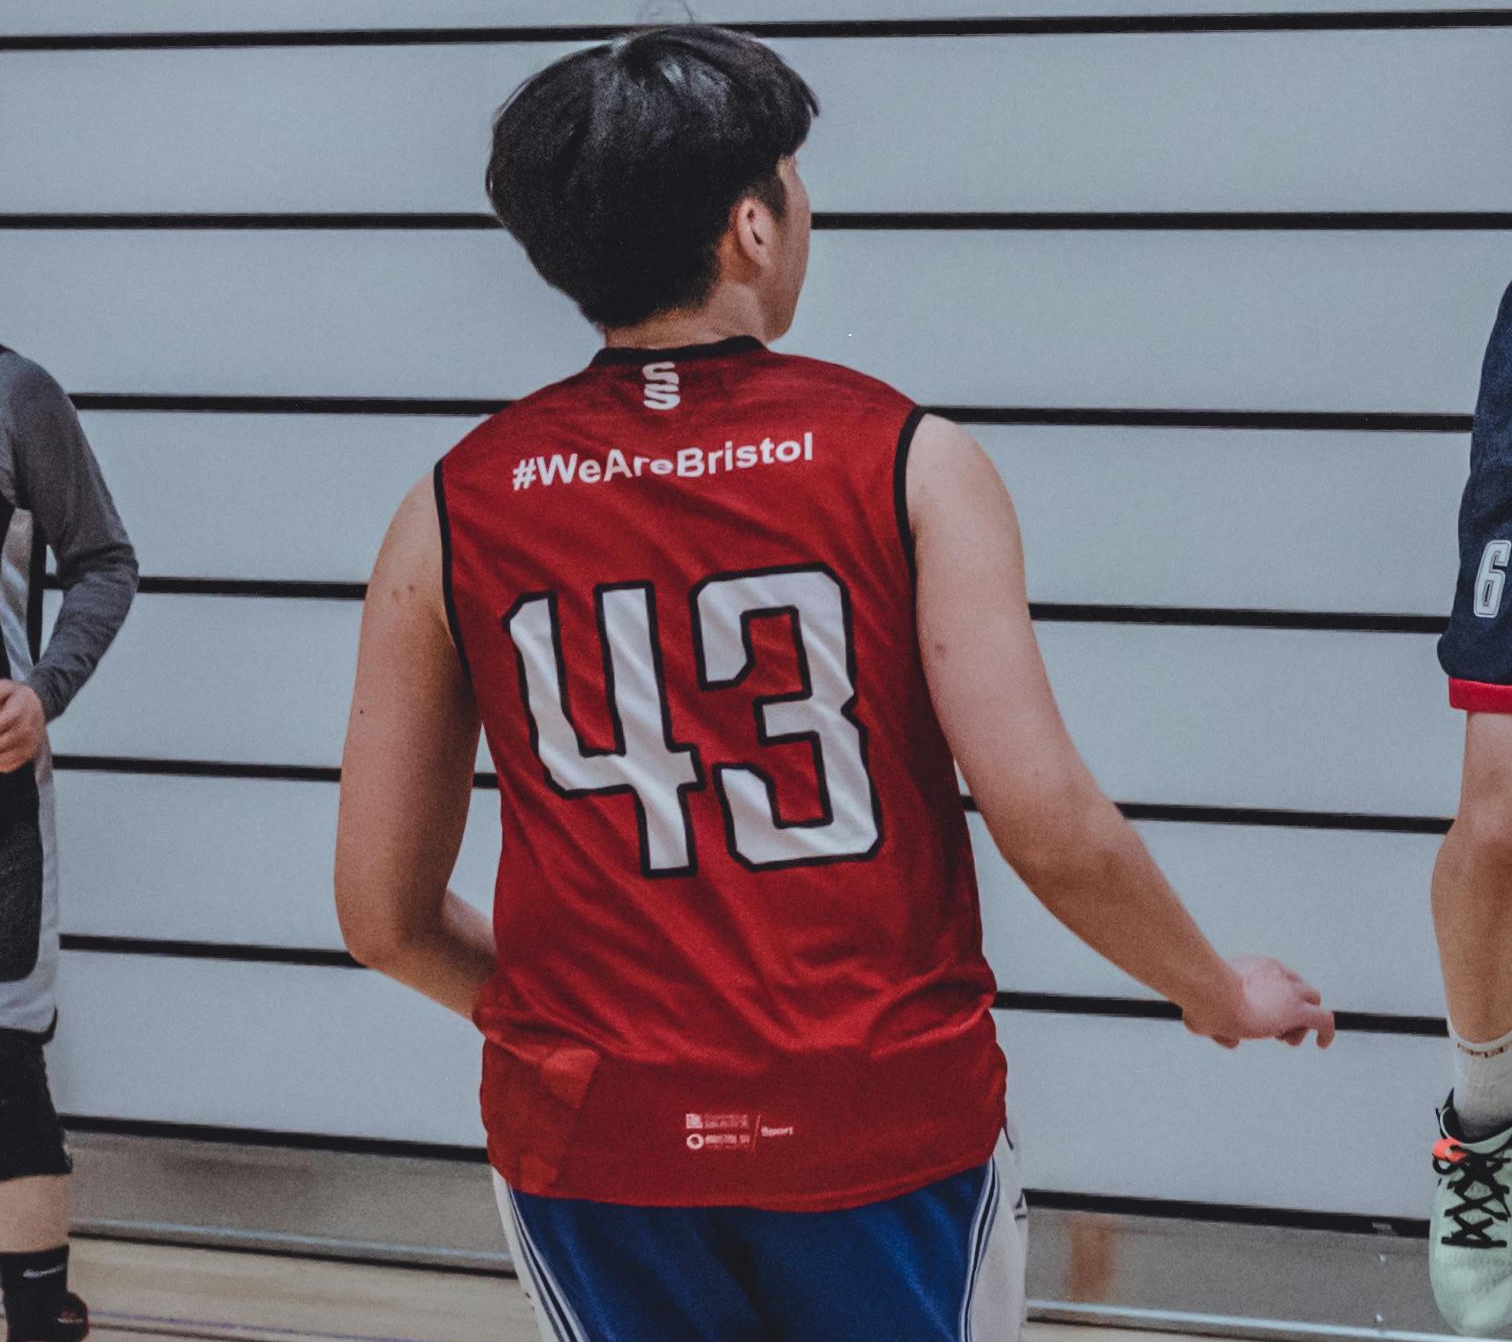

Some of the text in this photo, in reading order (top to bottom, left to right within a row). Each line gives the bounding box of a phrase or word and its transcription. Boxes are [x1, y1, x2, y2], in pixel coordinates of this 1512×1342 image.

[512, 432, 814, 491] #WeAreBristol
[1473, 539, 1512, 619] 6
[501, 562, 884, 878] 43
